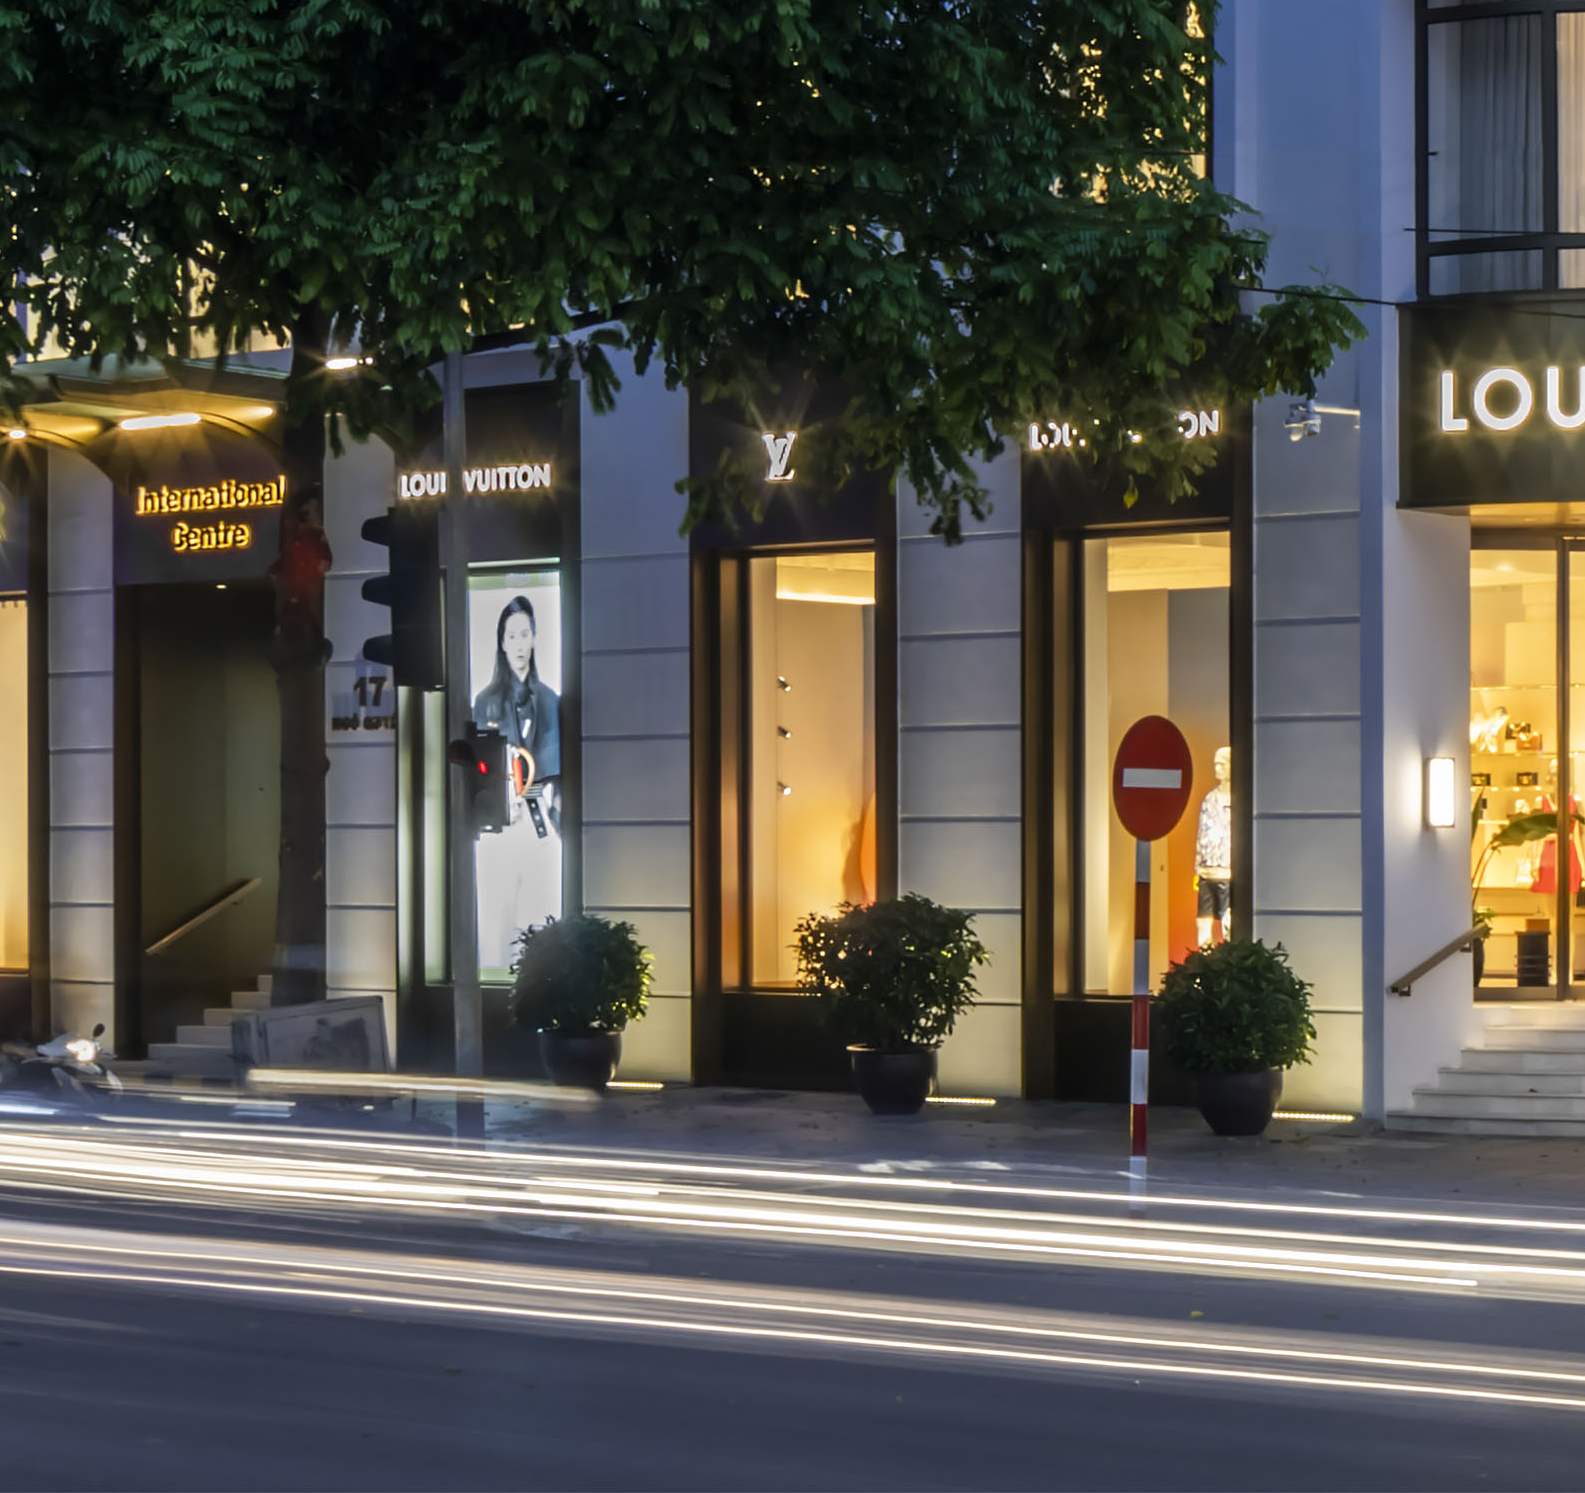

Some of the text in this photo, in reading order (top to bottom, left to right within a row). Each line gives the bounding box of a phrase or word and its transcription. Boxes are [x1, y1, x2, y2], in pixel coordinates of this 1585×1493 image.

[135, 474, 287, 516] International
[399, 462, 552, 499] LOUI VUITTON
[173, 520, 251, 552] Centre
[353, 675, 387, 707] 17
